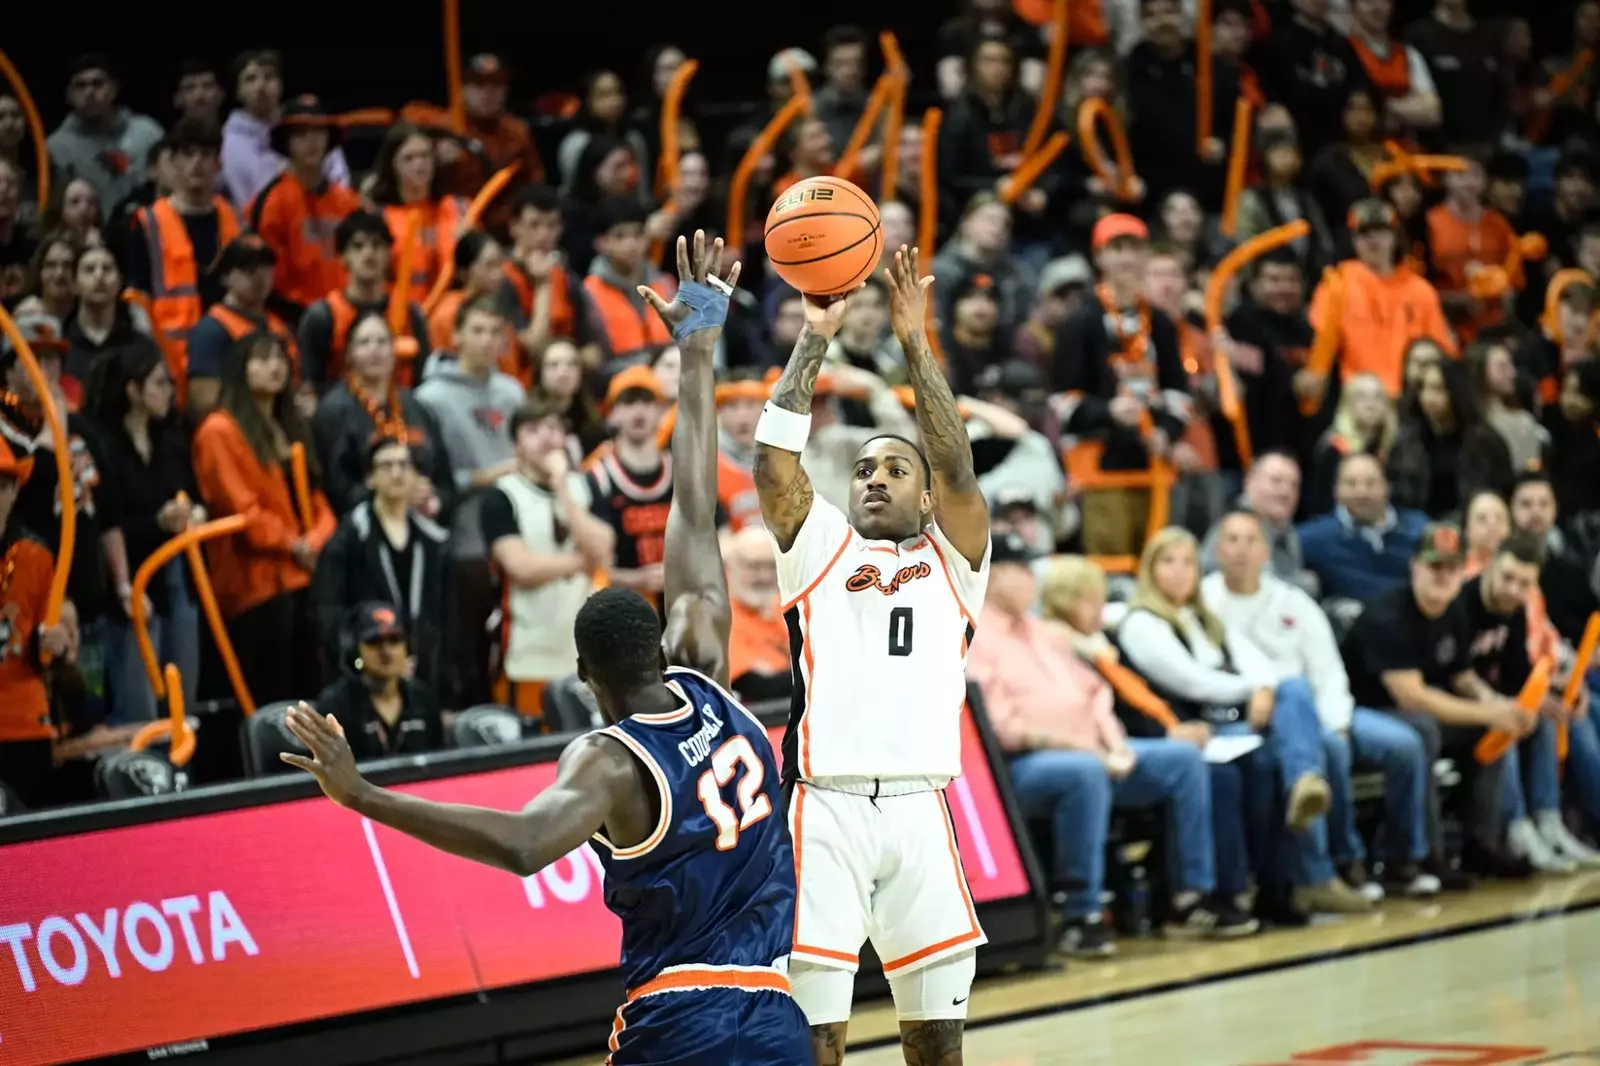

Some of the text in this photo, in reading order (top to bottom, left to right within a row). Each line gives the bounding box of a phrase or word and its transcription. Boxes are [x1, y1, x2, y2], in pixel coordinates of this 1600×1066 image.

[888, 607, 913, 656] 0
[697, 734, 773, 851] 12
[0, 890, 260, 992] TOYOTA
